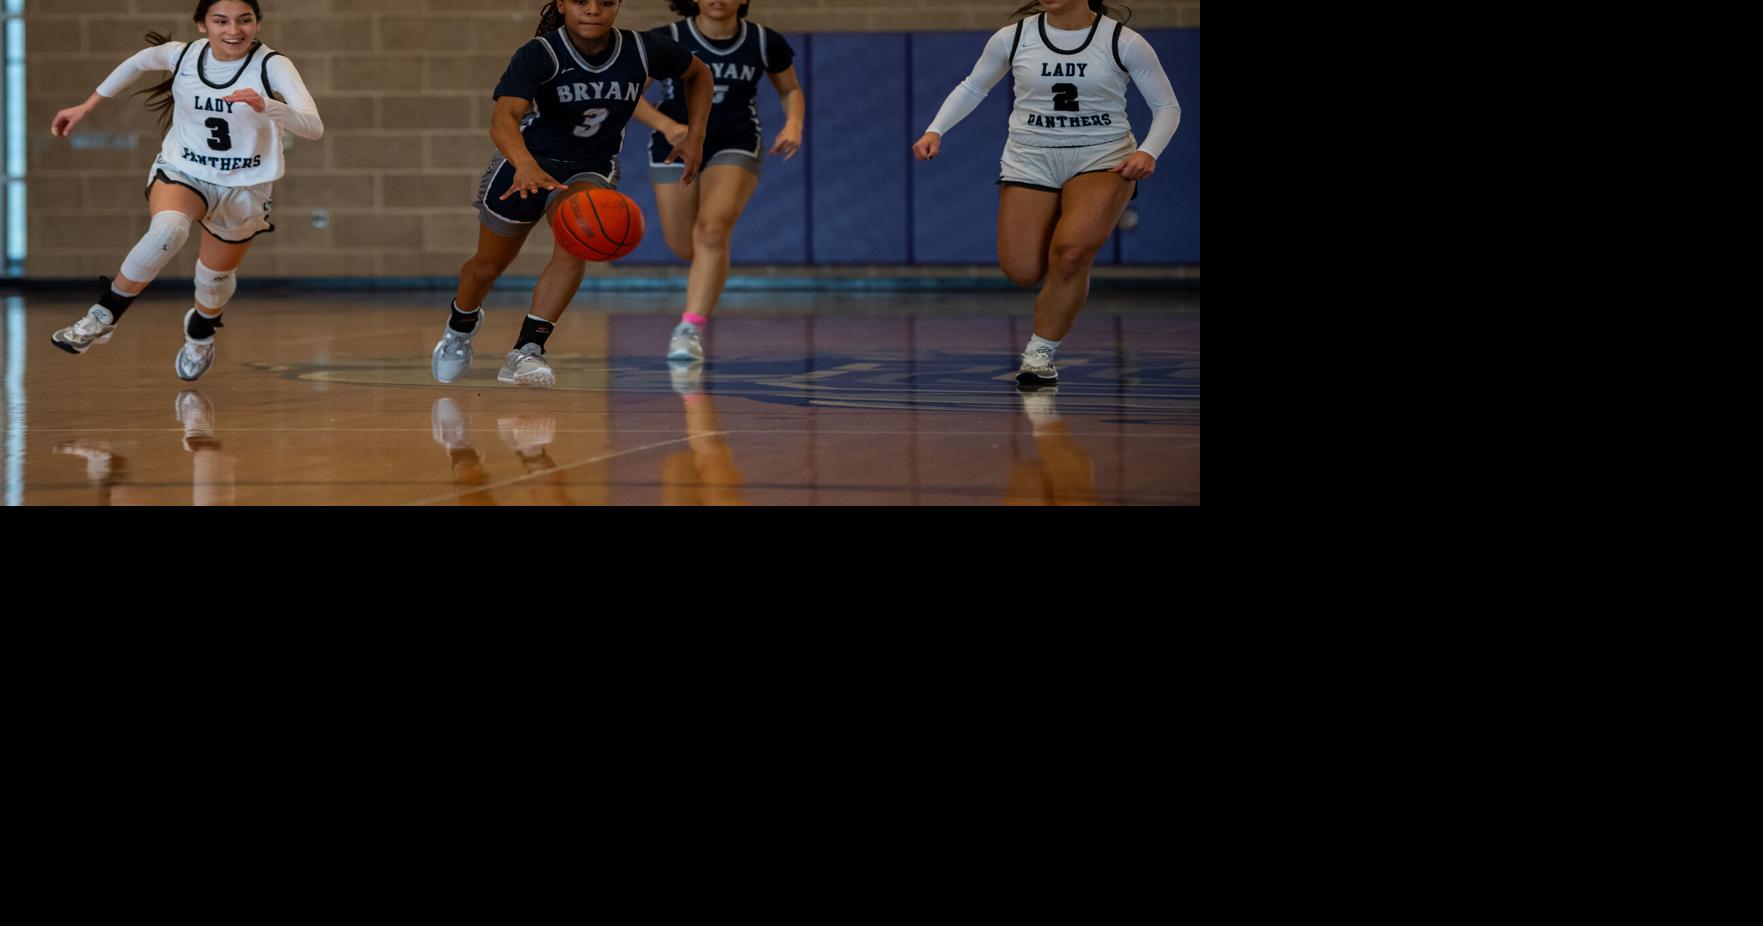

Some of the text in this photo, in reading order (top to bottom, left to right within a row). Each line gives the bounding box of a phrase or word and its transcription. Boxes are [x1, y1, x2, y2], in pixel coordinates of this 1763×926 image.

[707, 62, 756, 82] YAN
[1041, 62, 1088, 77] LADY
[556, 81, 640, 103] BRYAN
[1051, 82, 1080, 112] 2
[194, 95, 234, 114] LADY
[572, 107, 610, 138] 3
[1027, 113, 1112, 128] PANTHERS
[204, 116, 232, 152] 3
[181, 146, 261, 171] PANTHERS
